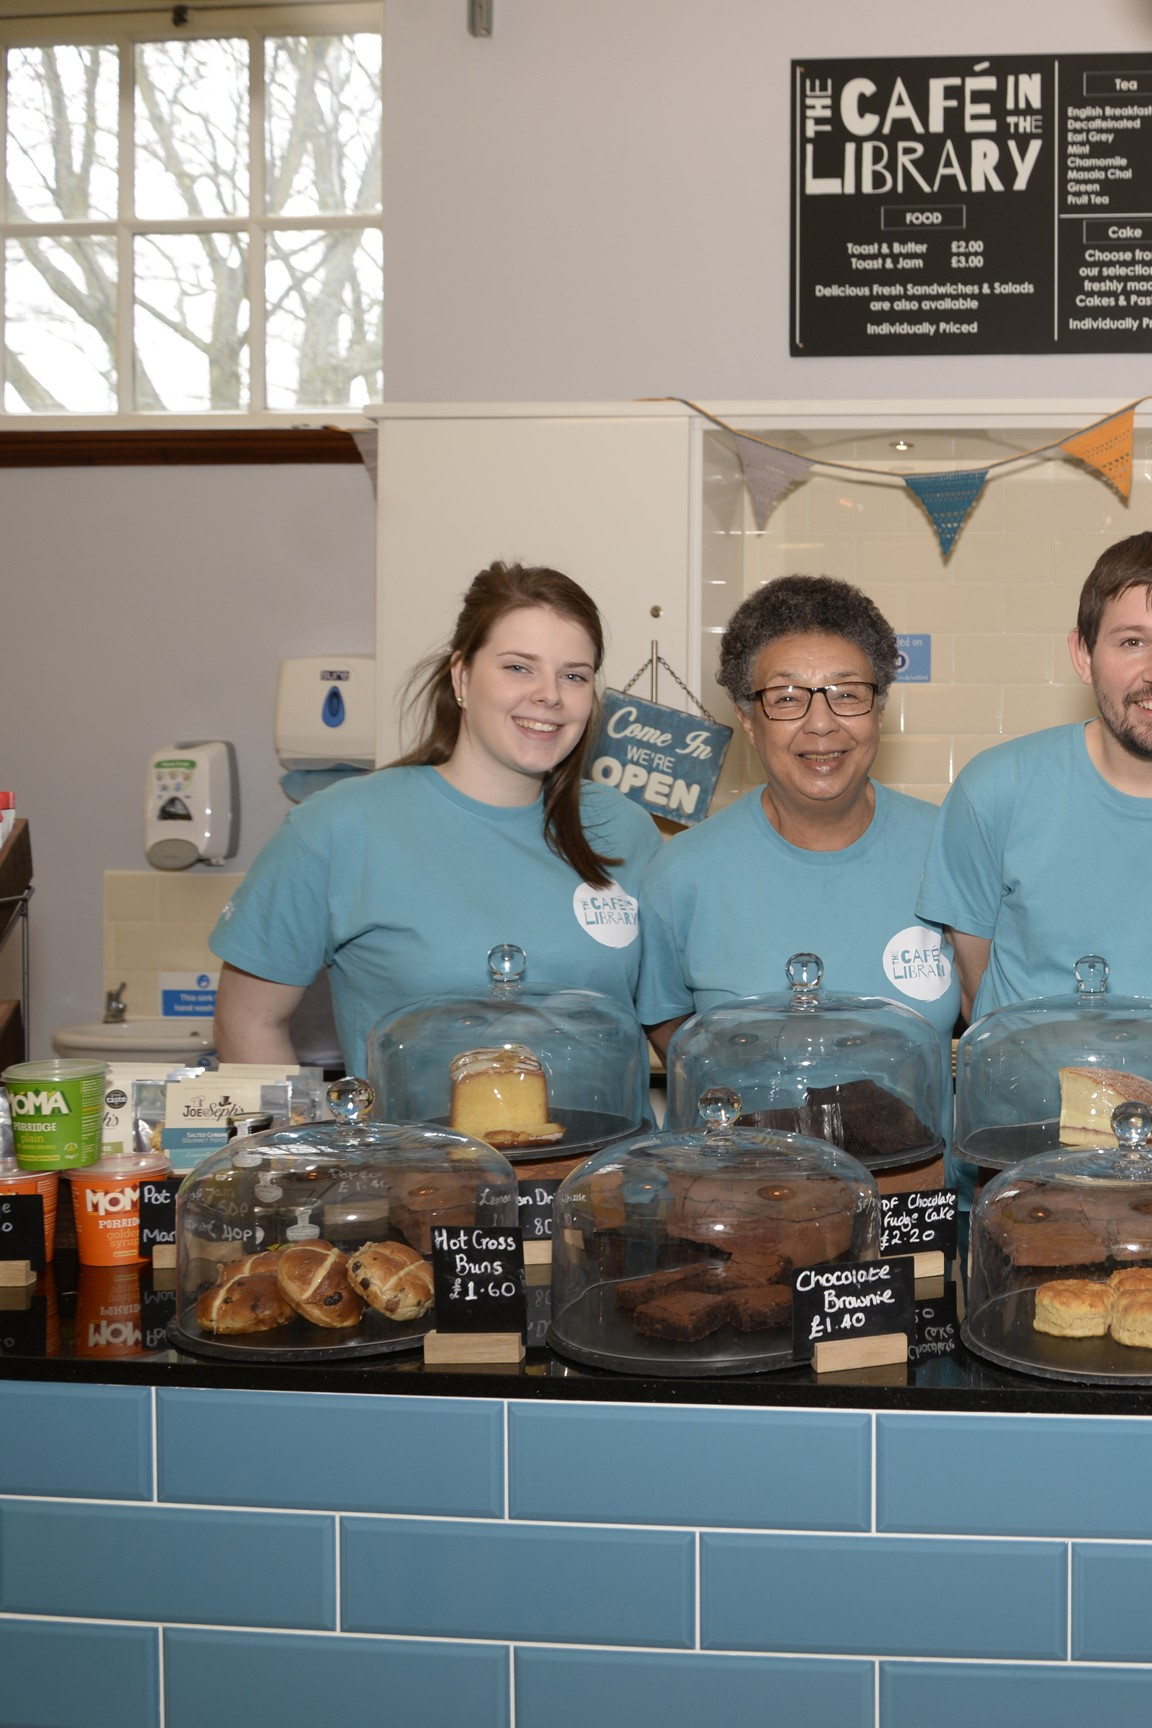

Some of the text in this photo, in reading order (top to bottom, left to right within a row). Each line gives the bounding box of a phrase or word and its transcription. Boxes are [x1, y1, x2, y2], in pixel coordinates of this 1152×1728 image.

[1006, 73, 1041, 110] IN
[1115, 79, 1137, 90] Tea
[840, 61, 997, 136] CAFÉ
[805, 79, 831, 138] THE
[1105, 105, 1152, 116] Breakfast
[1006, 115, 1042, 133] THE
[1068, 131, 1114, 143] Earl Grey
[1067, 144, 1089, 154] Mint
[805, 139, 1042, 195] LIBRARY
[1067, 156, 1127, 167] Chamomile
[1067, 169, 1132, 179] Masala Chai
[1067, 182, 1100, 192] Green
[1068, 194, 1109, 205] Fruit Tea
[906, 212, 942, 224] FOOD
[1108, 226, 1142, 238] Cake
[847, 241, 983, 254] Toast Butter £2.00
[1085, 249, 1137, 261] Choose
[851, 256, 983, 269] Toast Jam £3.00
[1079, 267, 1099, 276] our
[816, 282, 1034, 296] Delicious Fresh Sandwiches Salads
[1084, 280, 1124, 293] freshly
[870, 298, 978, 311] are also available
[1076, 295, 1115, 307] Cakes
[867, 322, 977, 336] Individually Priced
[1069, 317, 1139, 331] Individually
[607, 706, 712, 760] Come In
[627, 744, 675, 773] WE'RE
[592, 756, 701, 814] OPEN
[584, 911, 637, 926] LIBRARY
[143, 1185, 171, 1204] Pot
[907, 1193, 956, 1208] Chocolate
[434, 1228, 516, 1251] Hot Cross
[880, 1229, 935, 1250] £2.20
[455, 1254, 503, 1276] Buns
[796, 1264, 891, 1291] Chocolate
[449, 1278, 516, 1300] £1.60
[824, 1289, 895, 1313] Brownie
[809, 1313, 865, 1340] £1.40
